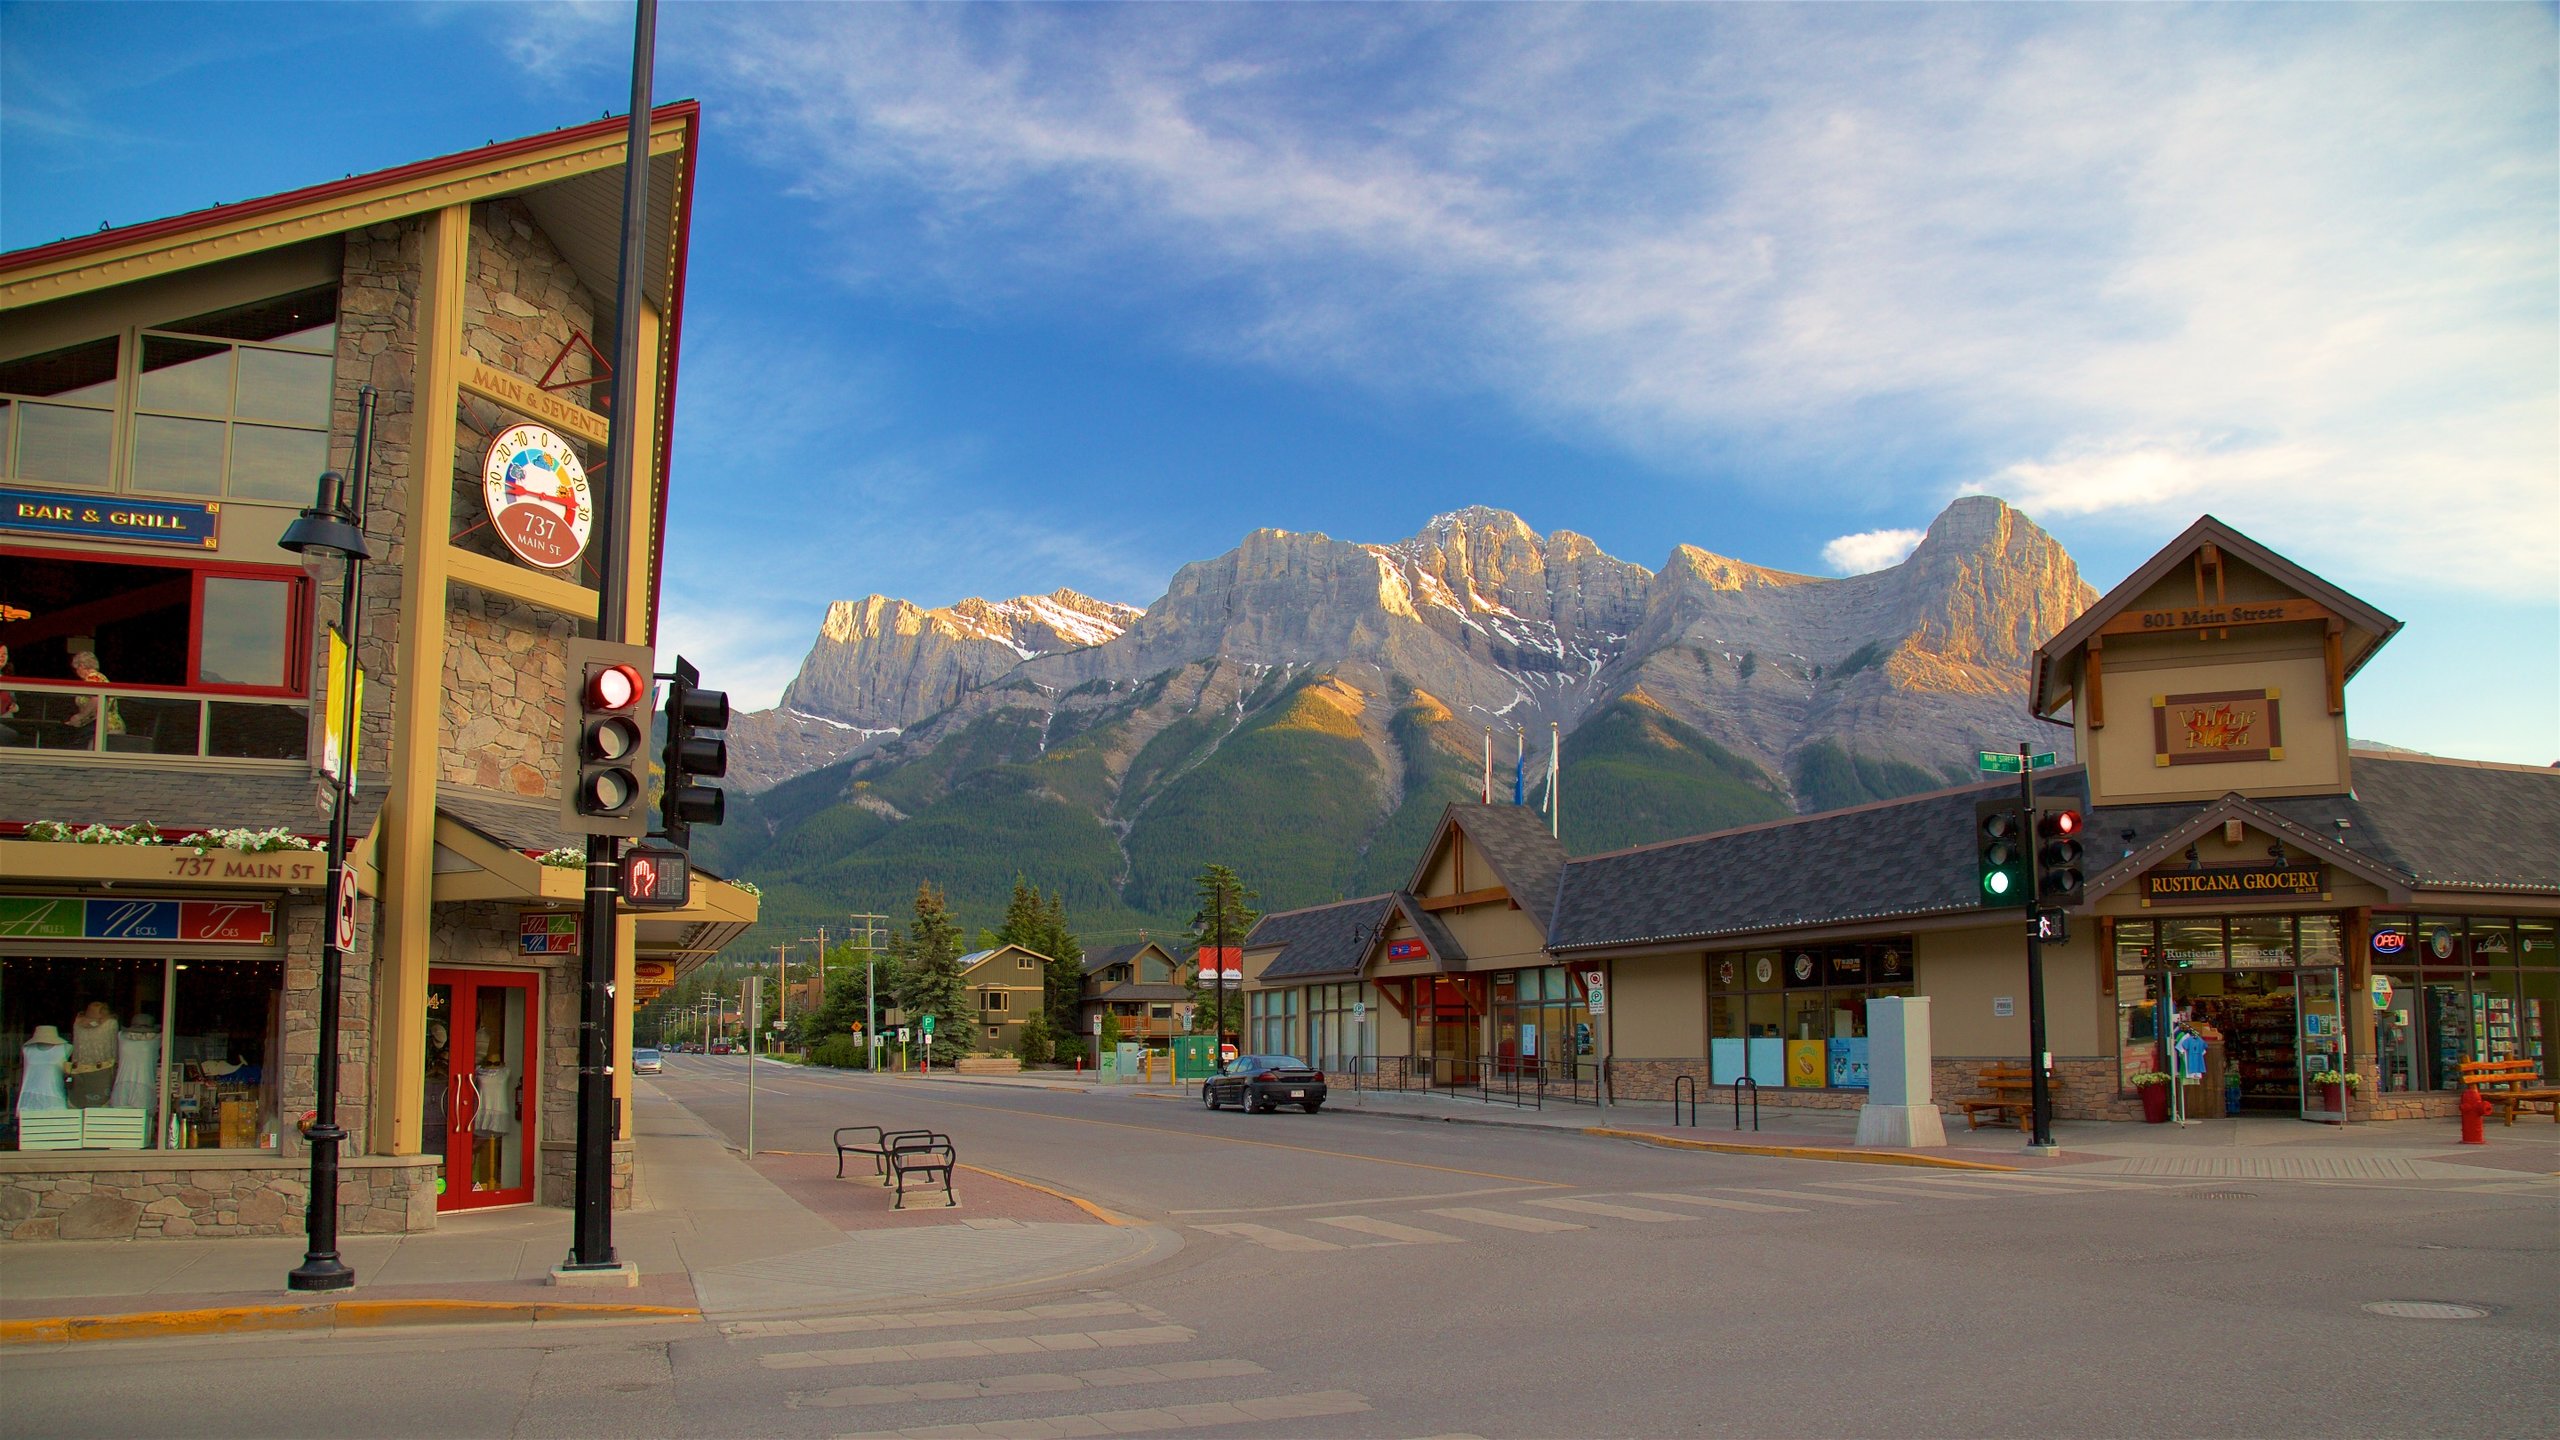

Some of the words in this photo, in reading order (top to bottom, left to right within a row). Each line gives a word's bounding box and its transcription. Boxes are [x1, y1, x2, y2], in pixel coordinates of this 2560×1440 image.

[472, 367, 522, 402] MAIN
[527, 393, 538, 409] &
[541, 433, 548, 448] 0
[560, 449, 573, 466] 10
[573, 476, 586, 492] 20
[18, 503, 73, 521] BAR
[82, 509, 101, 523] &
[110, 512, 187, 530] GRILL
[578, 504, 589, 522] 30
[523, 512, 557, 540] 737
[517, 533, 546, 551] MAIN
[2143, 612, 2174, 627] 801
[2182, 610, 2226, 626] Main
[2232, 606, 2284, 622] Street
[2177, 704, 2257, 731] Village
[2186, 729, 2249, 748] Plaza
[175, 857, 215, 877] 737
[224, 861, 282, 878] MAIN
[291, 864, 314, 880] ST
[2151, 874, 2241, 893] RUSTICANA
[2243, 871, 2319, 889] GROCERY
[2376, 934, 2404, 947] OPEN
[2166, 948, 2220, 959] Rusticana
[2240, 947, 2288, 961] Grocery
[427, 993, 439, 1010] 4
